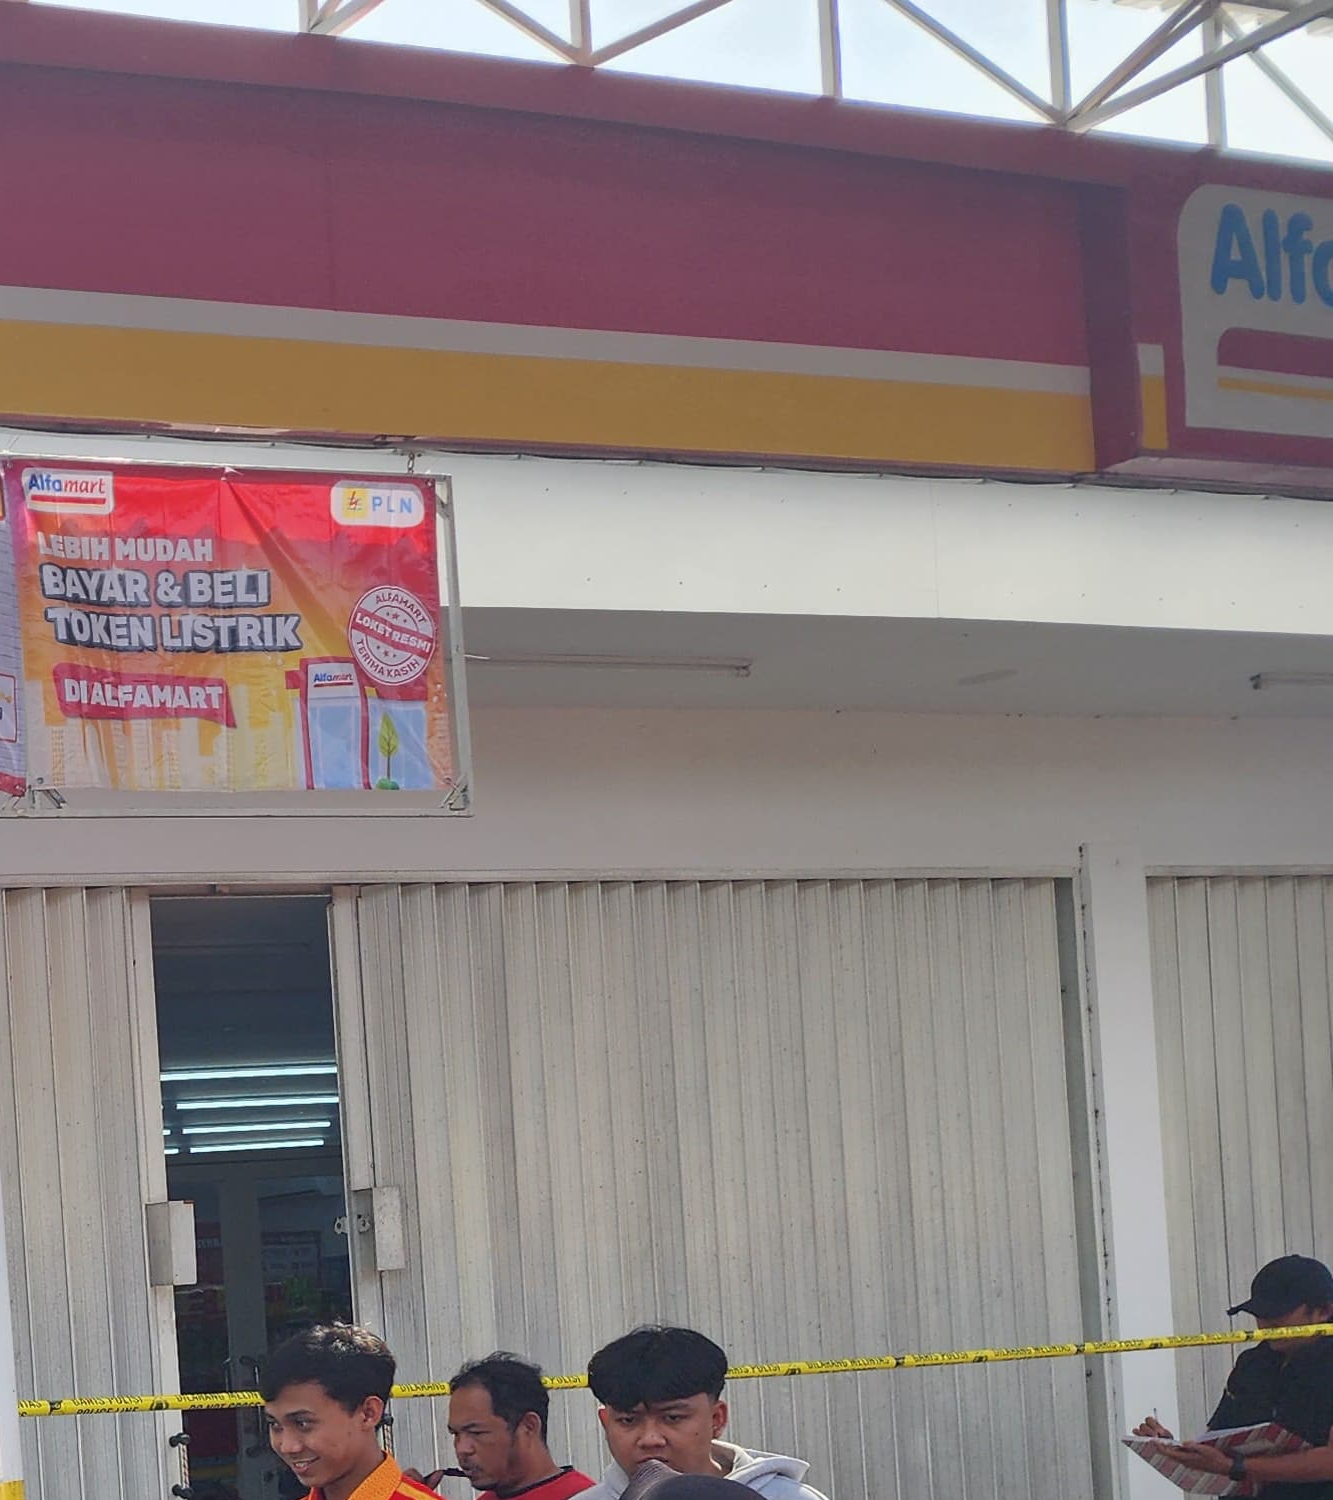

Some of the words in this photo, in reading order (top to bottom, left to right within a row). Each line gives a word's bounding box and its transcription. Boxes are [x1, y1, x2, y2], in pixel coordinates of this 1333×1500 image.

[28, 473, 106, 495] Alfamart
[371, 495, 413, 514] PLN
[36, 531, 110, 561] LEBIH
[114, 536, 214, 562] MUDAH
[41, 564, 150, 604] BAYAR
[156, 570, 183, 604] &
[188, 570, 270, 604] BELI
[375, 592, 428, 624] ALFAMART
[46, 606, 154, 649] TOKEN
[161, 615, 302, 649] LISTRIK
[355, 612, 393, 638] LOKET
[391, 631, 432, 654] RESMI
[356, 638, 388, 677] TERIMA
[386, 658, 421, 679] KASIH
[313, 672, 354, 683] Alfamart
[64, 678, 88, 705] DI
[90, 682, 224, 709] ALFAMART
